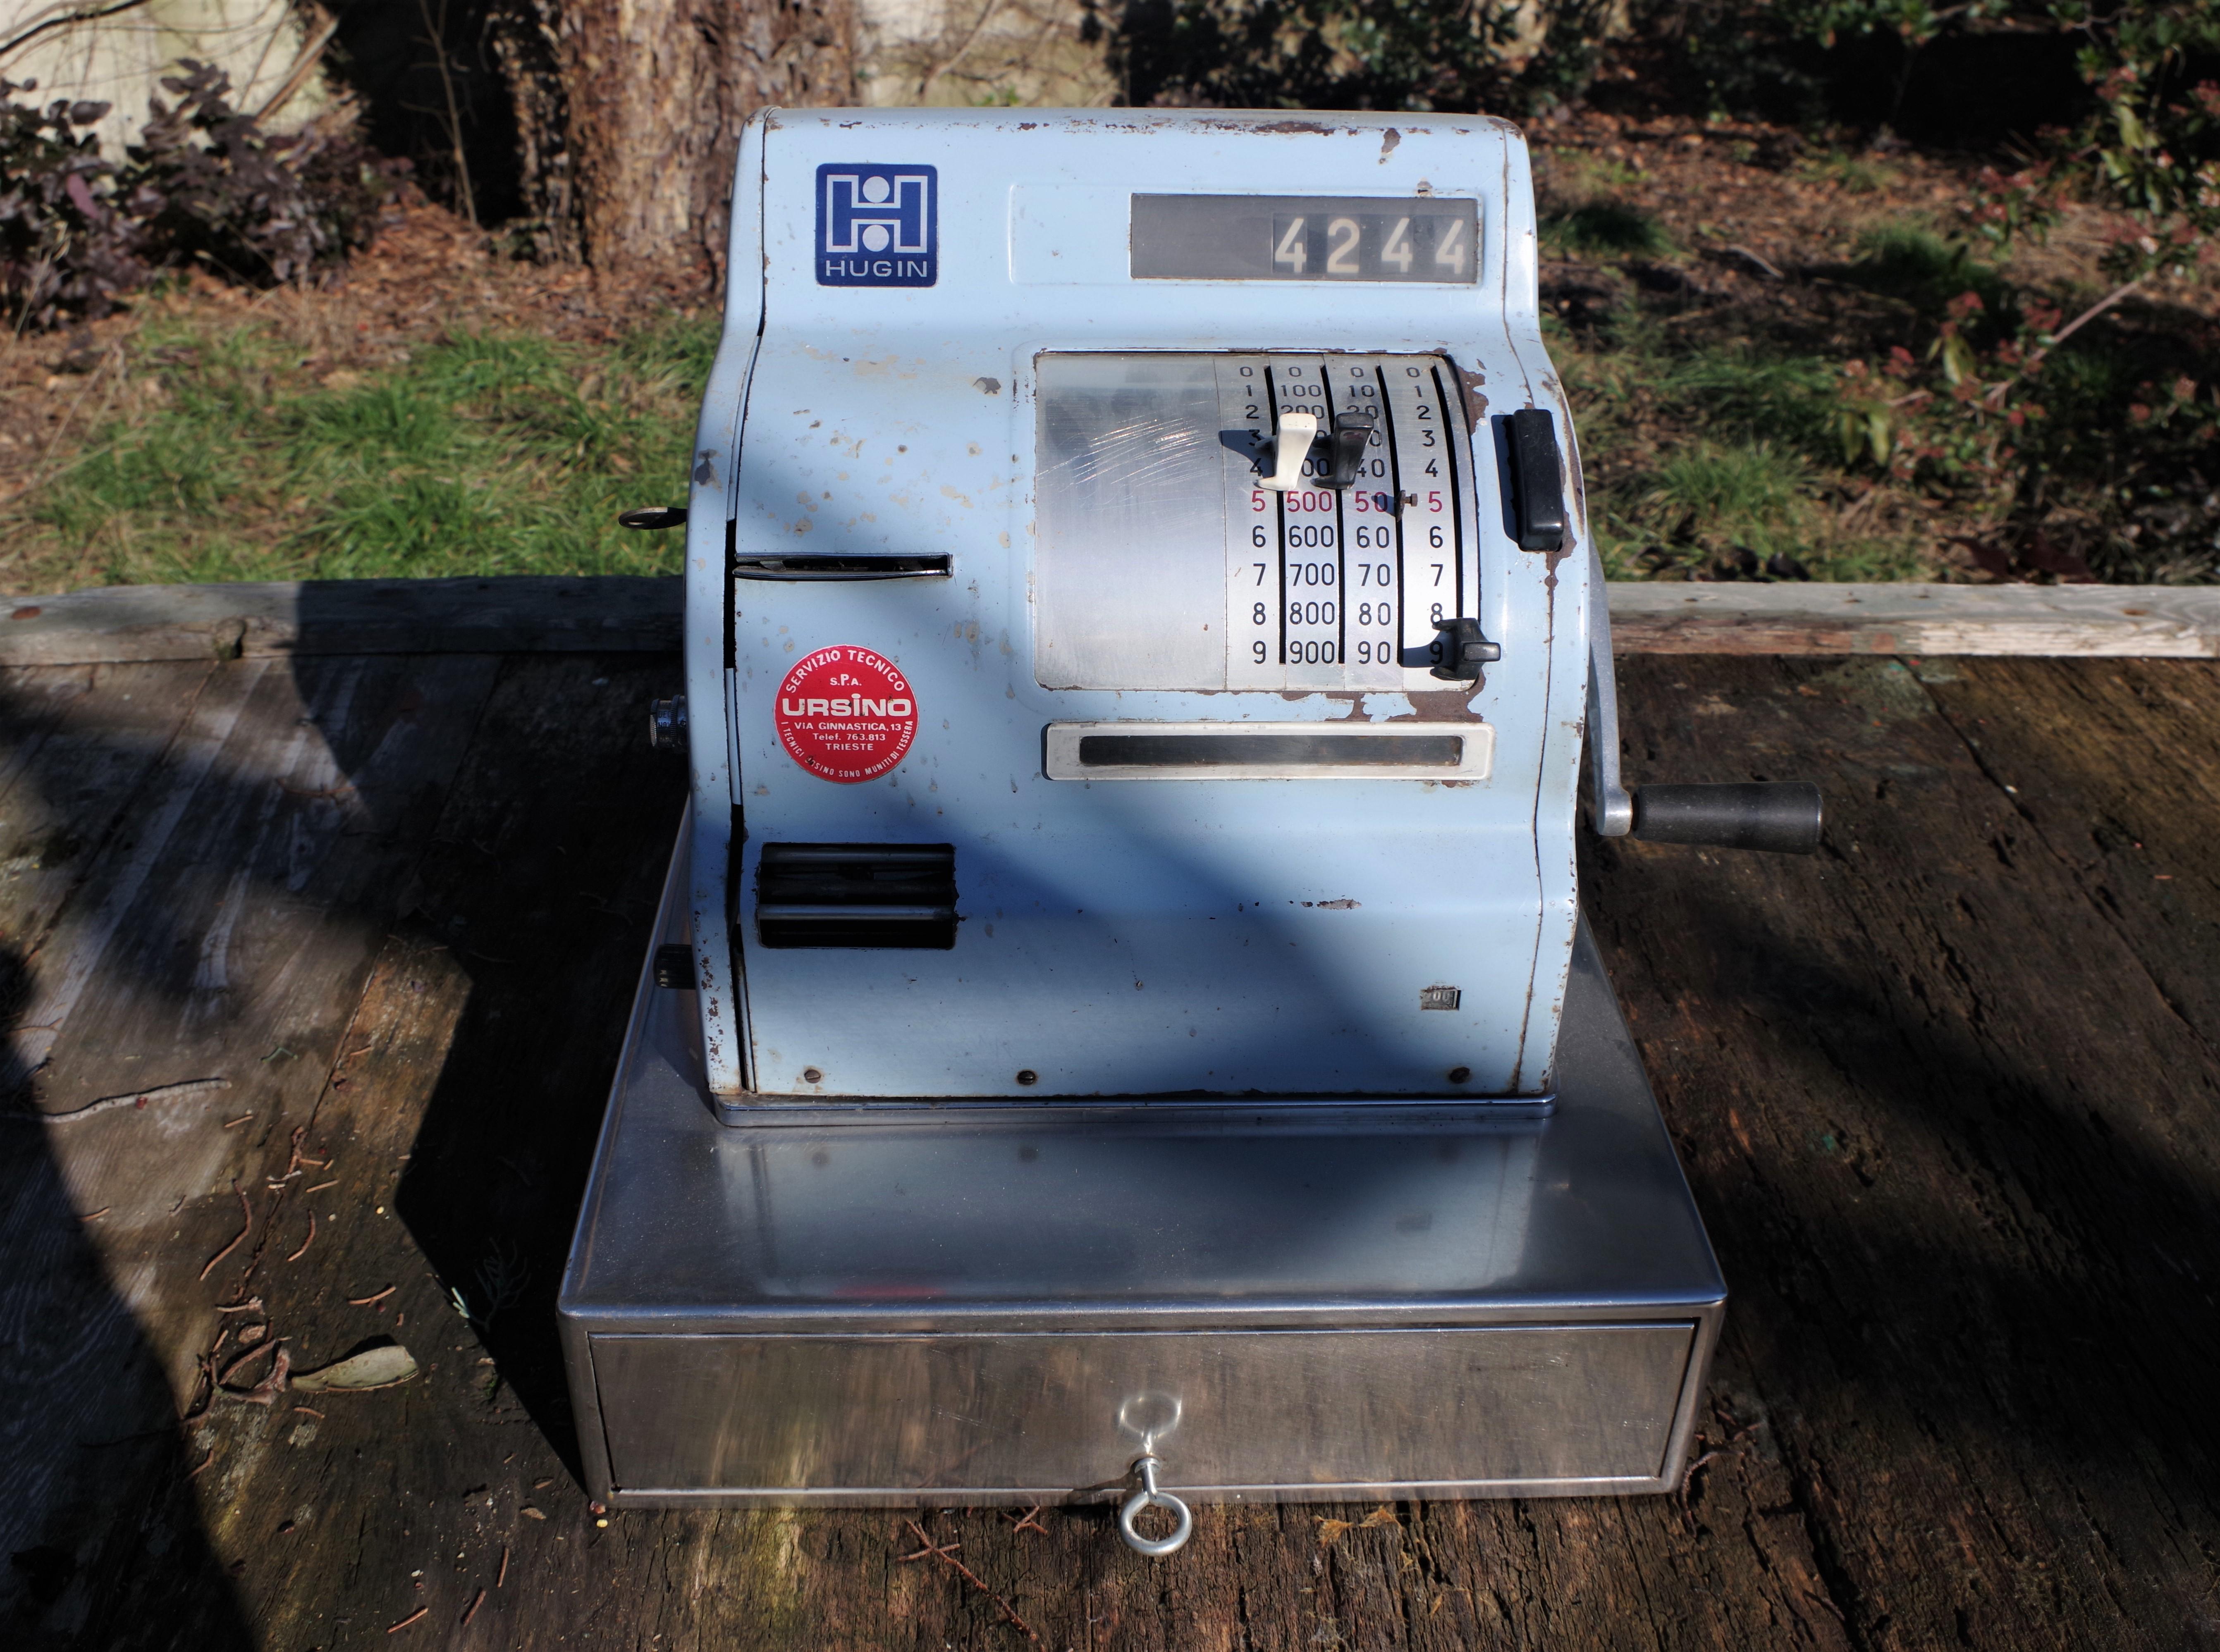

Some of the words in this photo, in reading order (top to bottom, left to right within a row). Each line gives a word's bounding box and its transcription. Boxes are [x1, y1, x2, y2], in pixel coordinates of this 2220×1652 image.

[826, 260, 927, 277] HUGIN
[1240, 367, 1253, 377] 0
[1288, 367, 1302, 377] 0
[1350, 367, 1364, 378] 0
[1406, 367, 1420, 377] 0
[1246, 385, 1252, 397] 1
[1281, 385, 1322, 397] 100
[1349, 385, 1375, 397] 10
[1415, 385, 1422, 398] 1
[1245, 405, 1259, 419] 2
[1417, 405, 1431, 420] 2
[1422, 430, 1435, 447] 3
[1250, 458, 1263, 477] 4
[1425, 458, 1438, 477] 4
[1252, 491, 1266, 512] 5
[1286, 491, 1332, 512] 500
[1354, 491, 1388, 512] 50
[1429, 491, 1442, 512] 5
[1252, 525, 1266, 548] 6
[1289, 525, 1334, 548] 600
[1356, 525, 1389, 548] 60
[1429, 526, 1443, 548] 6
[1253, 563, 1266, 586] 7
[1290, 563, 1335, 586] 700
[1358, 563, 1390, 587] 70
[1431, 564, 1443, 586] 7
[1253, 602, 1266, 625] 8
[1290, 602, 1335, 625] 800
[1359, 602, 1391, 626] 80
[1430, 602, 1443, 624] 8
[1253, 640, 1266, 664] 9
[1290, 641, 1335, 664] 900
[1358, 641, 1391, 664] 90
[1429, 641, 1443, 664] 9
[786, 650, 841, 693] SERVIZIO
[848, 650, 905, 691] TECNICO
[830, 673, 862, 686] S.P.A.
[818, 722, 889, 732] GINNASTICA,
[783, 728, 805, 757] TECNICI
[864, 757, 893, 775] MUNITI
[890, 751, 900, 760] DI
[896, 721, 913, 751] TESSERA
